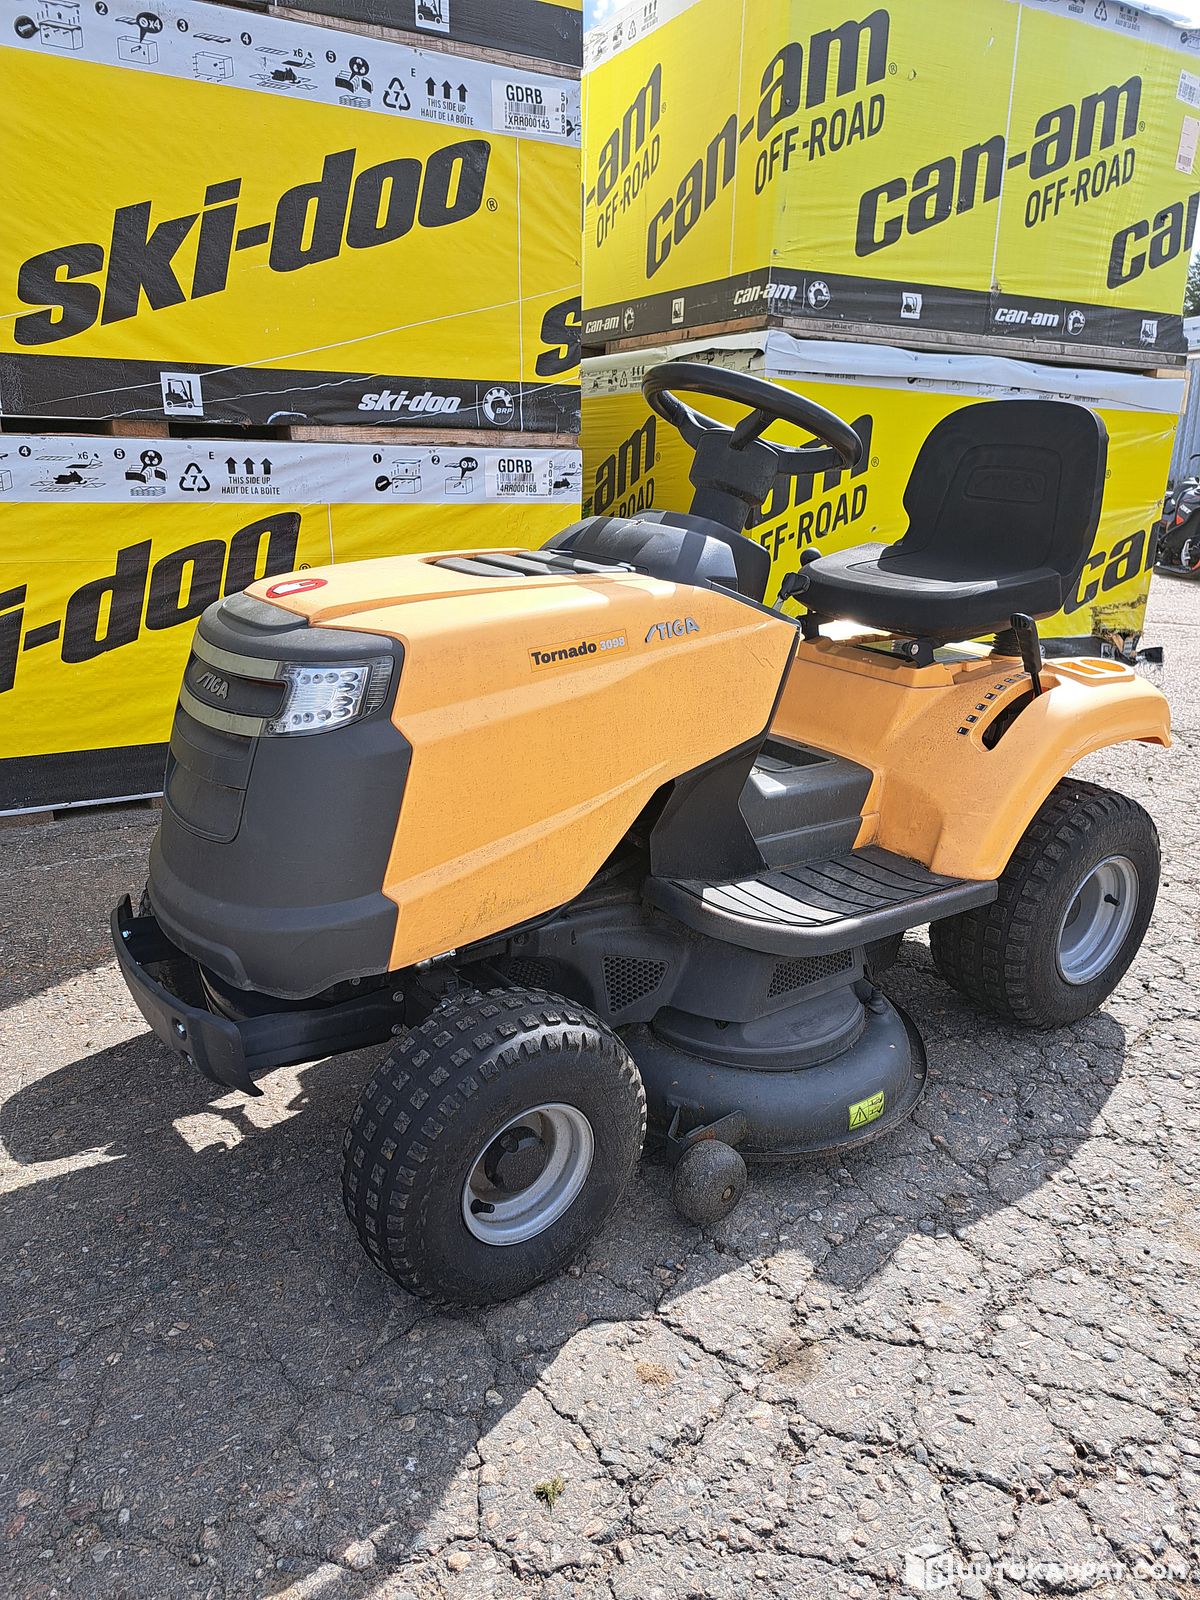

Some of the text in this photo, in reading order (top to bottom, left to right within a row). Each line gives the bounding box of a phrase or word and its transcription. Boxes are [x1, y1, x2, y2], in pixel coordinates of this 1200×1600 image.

[149, 20, 161, 31] x4
[293, 48, 303, 57] x6
[411, 68, 416, 77] E
[393, 91, 400, 101] 7
[506, 84, 543, 104] GDRB
[428, 98, 466, 112] THIS SIDE UP
[420, 108, 474, 126] HAUT DE LA BOÎTE
[646, 9, 890, 279] can-am
[755, 93, 885, 195] OFF-ROAD
[855, 75, 1142, 257] can-am
[597, 134, 660, 248] OFF-ROAD
[1024, 147, 1135, 228] OFF-ROAD
[14, 139, 491, 346] ski-doo
[733, 283, 798, 305] can-am
[585, 315, 620, 334] can-am
[994, 308, 1060, 327] can-am
[358, 390, 461, 413] ski-doo
[496, 407, 513, 415] BRP
[77, 452, 88, 460] x6
[209, 452, 215, 460] E
[498, 459, 533, 473] GDRB
[190, 475, 197, 485] 7
[245, 477, 260, 485] SIDE
[261, 477, 271, 485] UP
[250, 487, 259, 495] LA
[260, 485, 280, 495] BOÎTE
[645, 616, 700, 643] STIGA
[531, 636, 625, 665] Tornado 3098
[196, 671, 229, 699] STIGA
